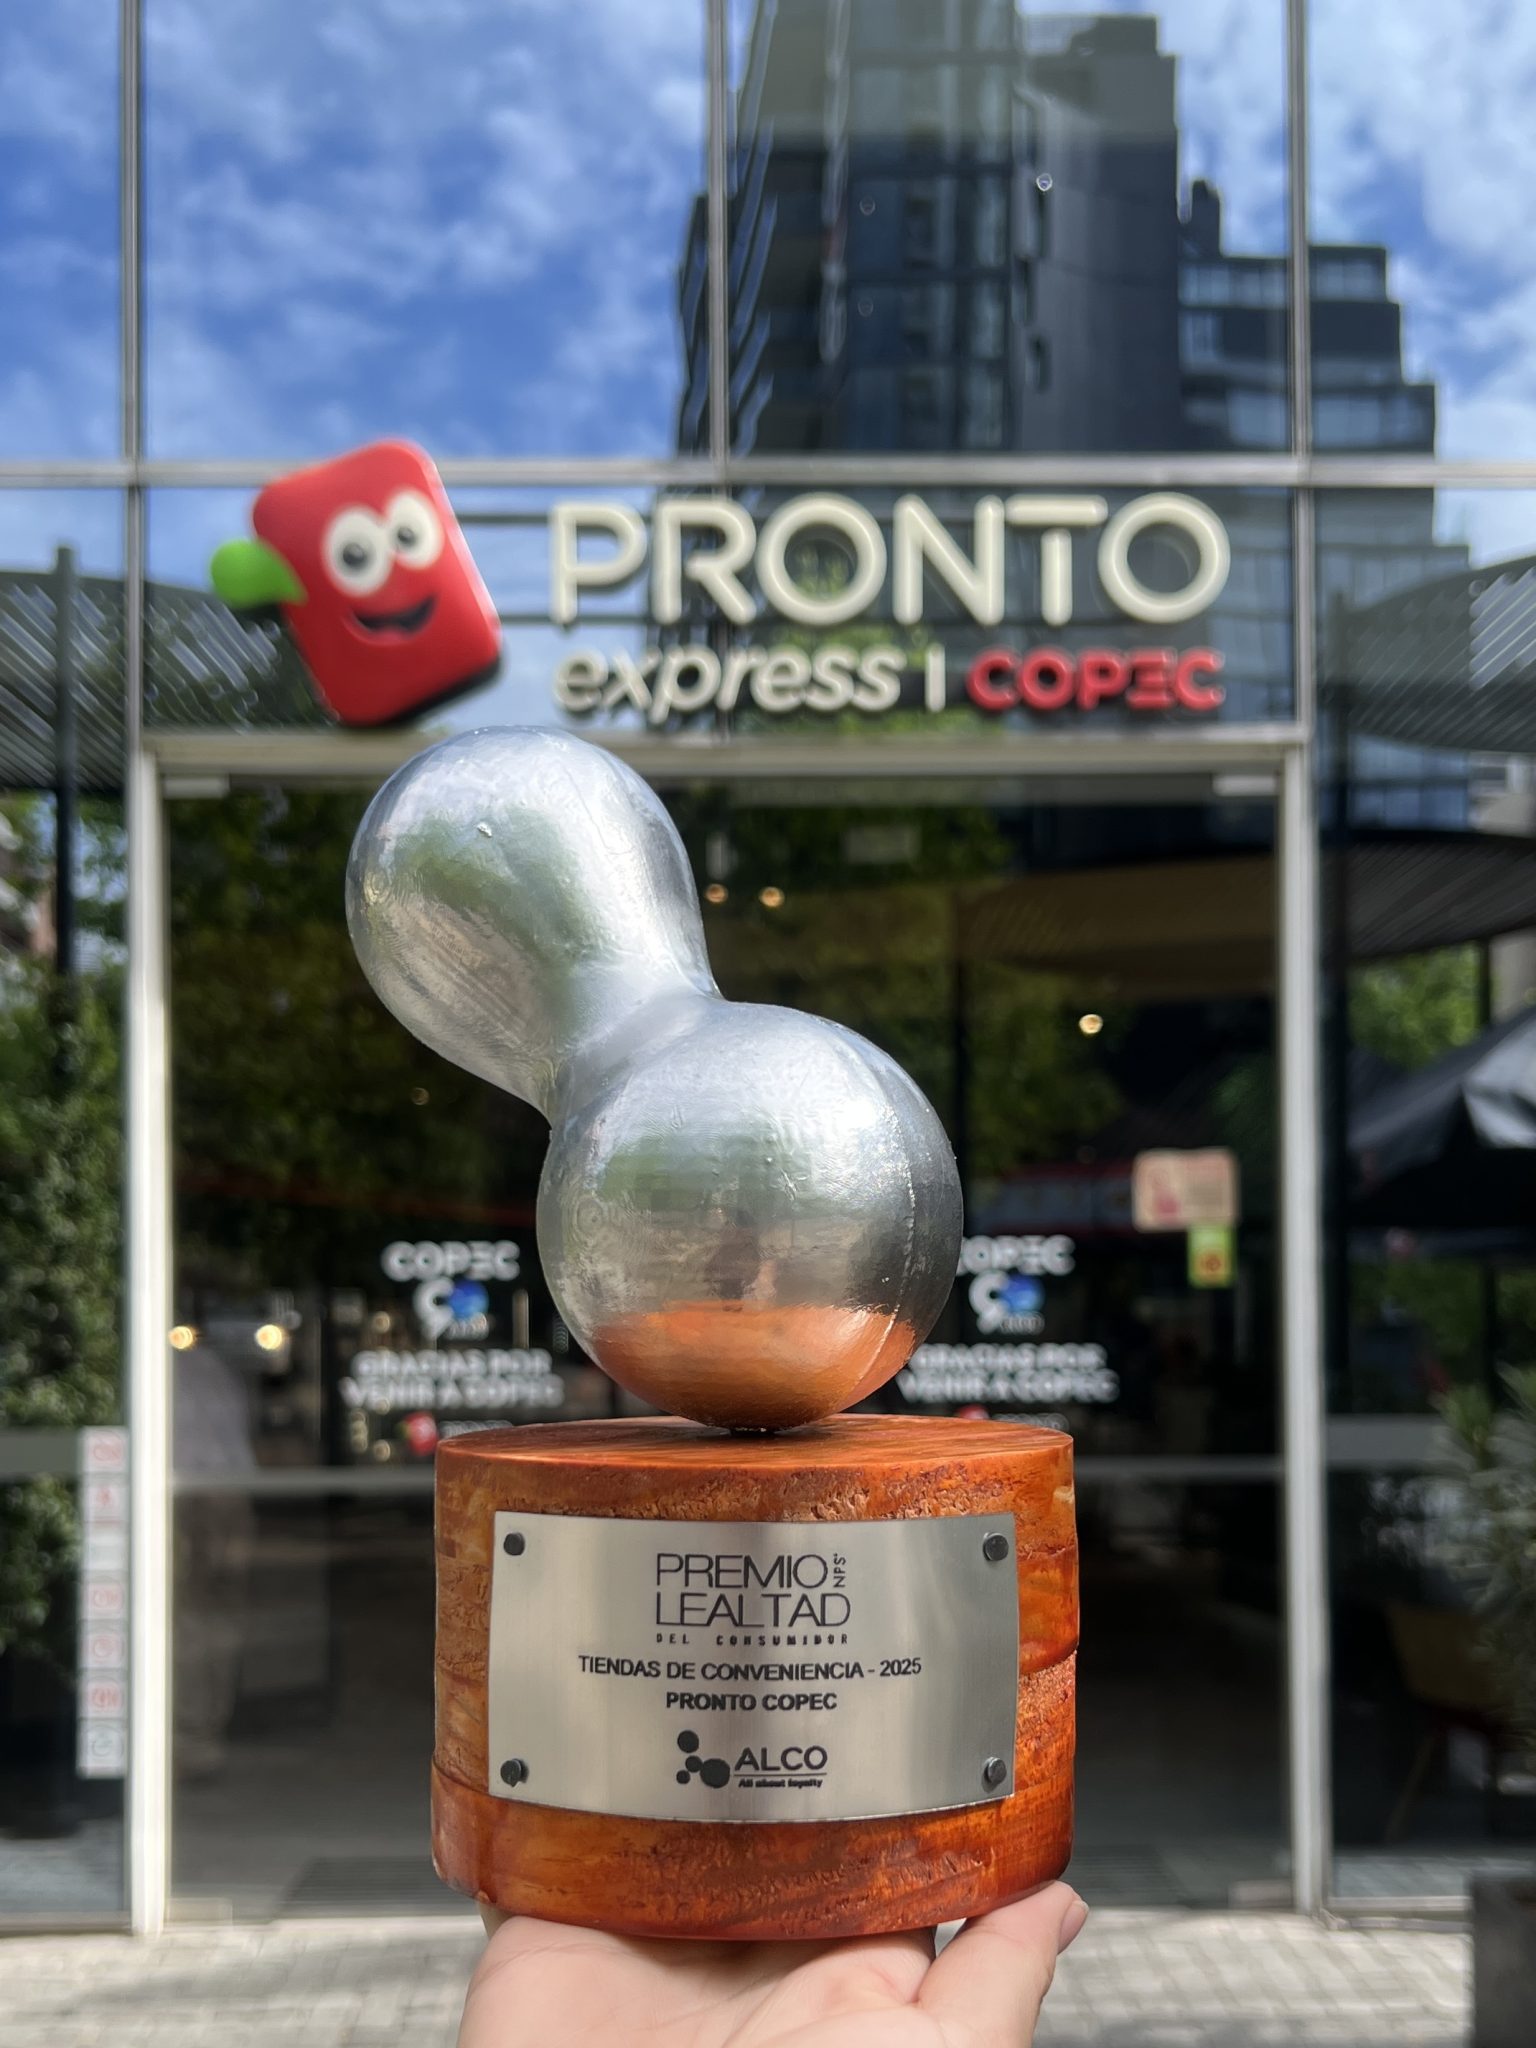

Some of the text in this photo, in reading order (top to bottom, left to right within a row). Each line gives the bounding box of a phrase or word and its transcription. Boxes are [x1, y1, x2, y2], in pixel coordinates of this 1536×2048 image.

[549, 492, 1230, 626] PRONTO
[552, 644, 1226, 724] express COPEC
[381, 1240, 520, 1282] COPEC
[960, 1234, 1075, 1276] OPEC
[656, 1553, 828, 1588] PREMIO
[656, 1592, 851, 1628] LEALTAD
[656, 1633, 848, 1646] DEL CONSUMIDOR
[578, 1655, 661, 1679] TIENDAS
[666, 1662, 696, 1680] DE
[701, 1661, 865, 1682] CONVENIENCIA
[879, 1657, 922, 1677] 2025
[665, 1692, 838, 1712] PRONTO COPEC
[734, 1745, 828, 1771] ALCO
[755, 1779, 786, 1788] about
[788, 1778, 823, 1790] loyalty
